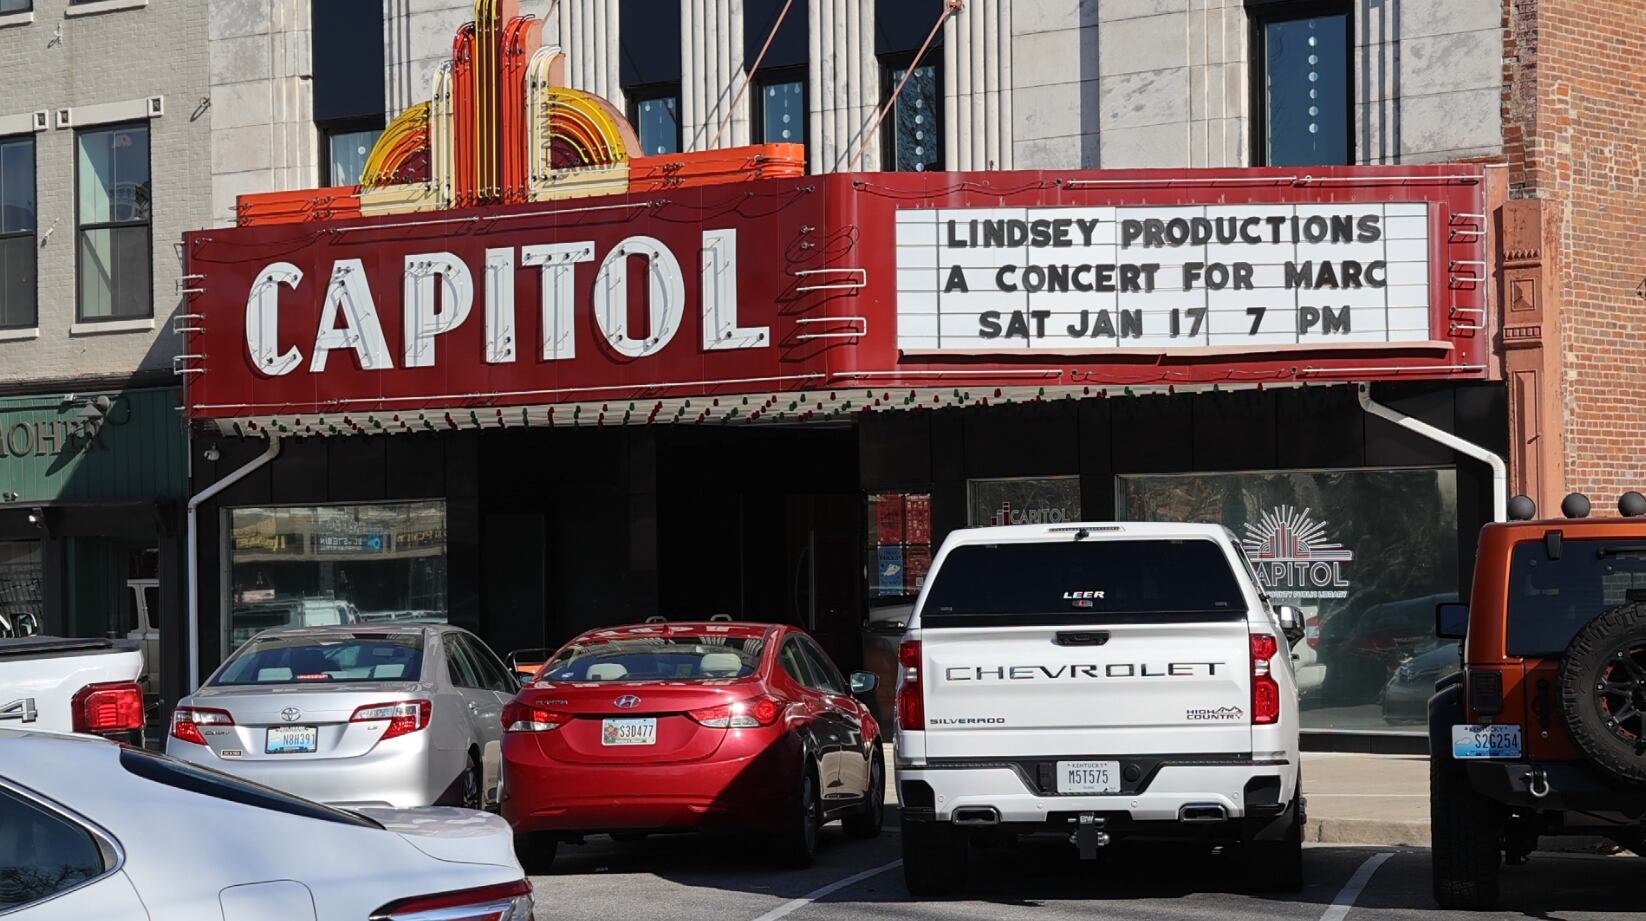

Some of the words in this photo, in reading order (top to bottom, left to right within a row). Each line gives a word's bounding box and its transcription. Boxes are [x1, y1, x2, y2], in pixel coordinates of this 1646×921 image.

[947, 218, 1100, 248] LINDSEY
[1121, 215, 1382, 247] PRODUCTIONS
[944, 264, 970, 293] A
[996, 263, 1161, 294] CONCERT
[1183, 261, 1255, 291] FOR
[1285, 259, 1388, 289] MARC
[245, 228, 771, 376] CAPITOL
[979, 310, 1053, 338] SAT
[1067, 309, 1143, 338] JAN
[1170, 307, 1207, 336] 17
[1247, 306, 1266, 335] 7
[1299, 305, 1352, 334] PM
[1010, 508, 1070, 525] CAPITOL
[1257, 562, 1349, 586] APITOL
[1063, 591, 1105, 600] LEER
[946, 662, 1226, 681] CHEVROLET
[1186, 708, 1216, 716] HIGH
[1475, 733, 1517, 748] S2G254
[1068, 769, 1109, 785] M5T575
